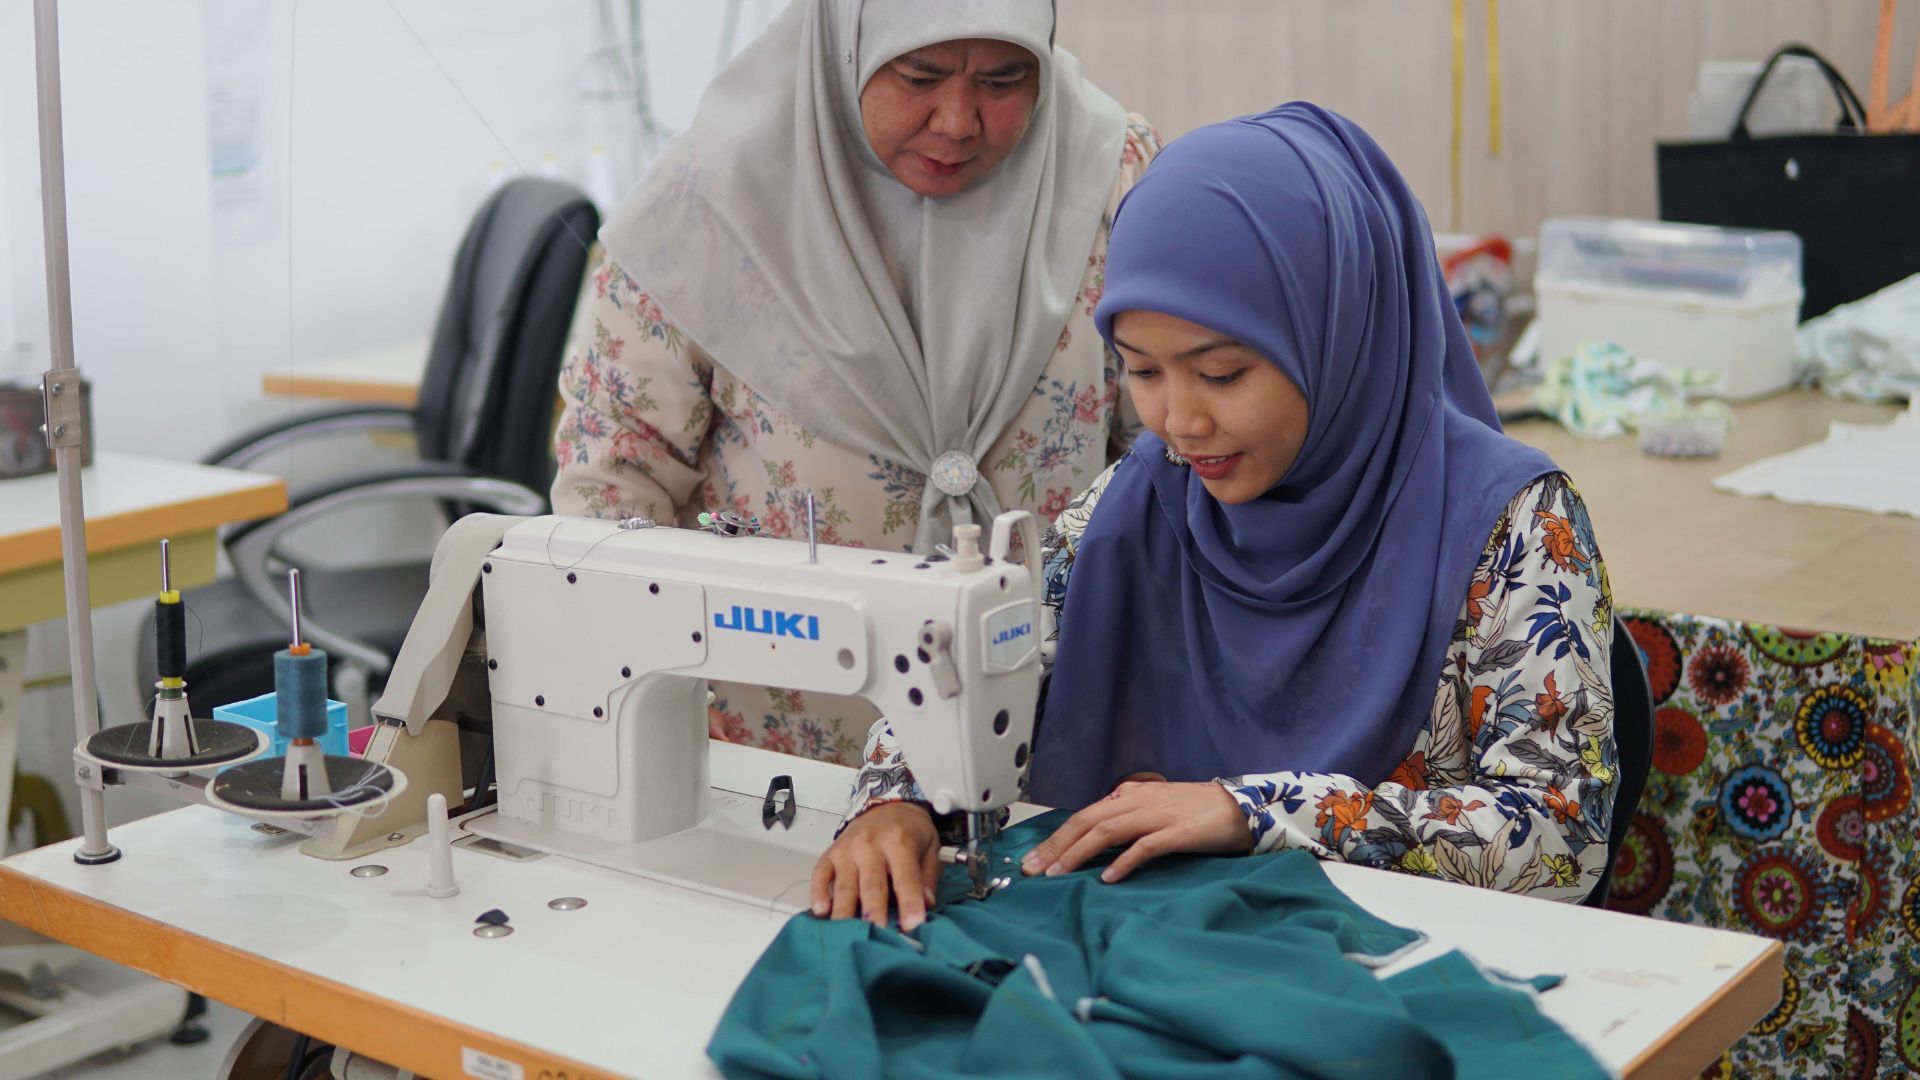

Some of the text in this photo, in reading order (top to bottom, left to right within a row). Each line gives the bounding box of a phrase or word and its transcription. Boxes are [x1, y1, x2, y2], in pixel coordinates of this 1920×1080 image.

[713, 605, 820, 641] JUKI
[992, 623, 1031, 645] JUKI
[526, 792, 616, 831] JUKI
